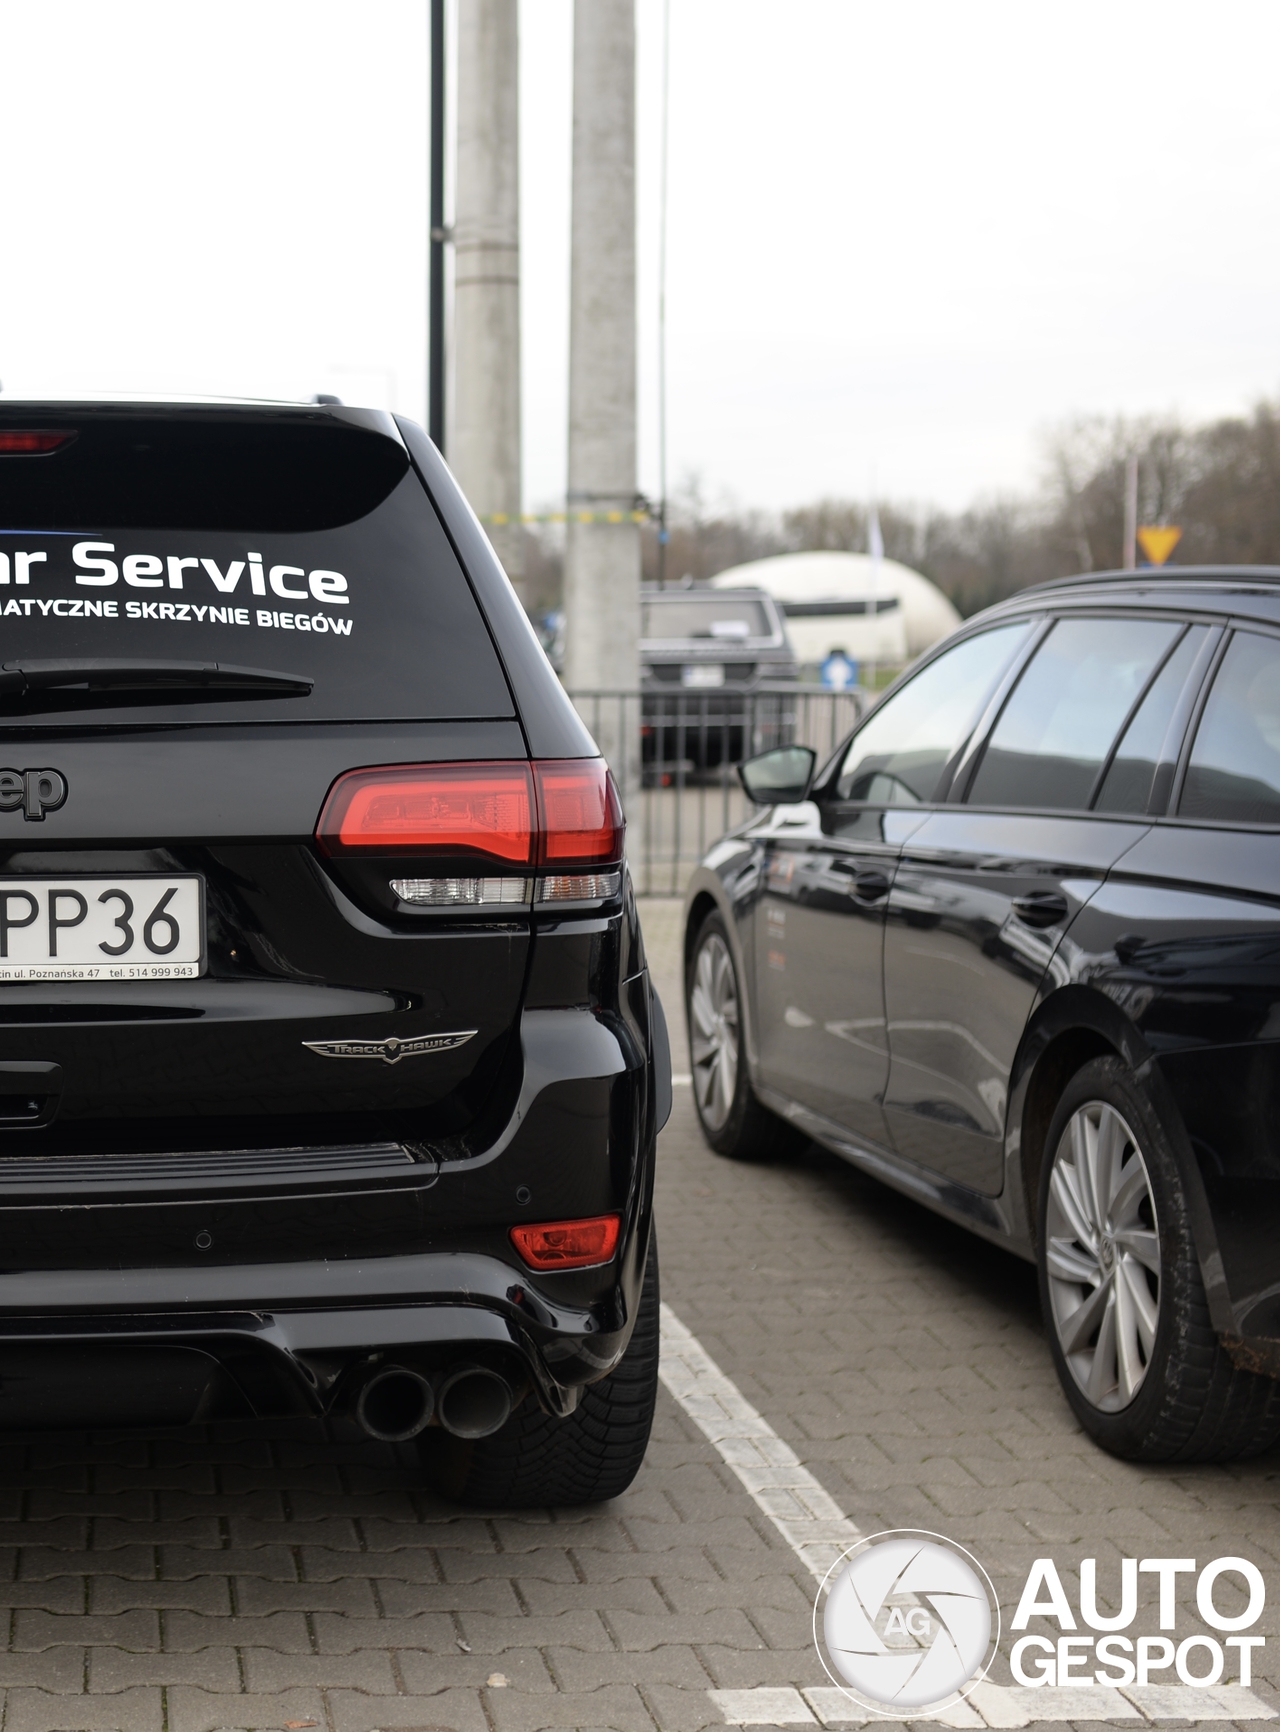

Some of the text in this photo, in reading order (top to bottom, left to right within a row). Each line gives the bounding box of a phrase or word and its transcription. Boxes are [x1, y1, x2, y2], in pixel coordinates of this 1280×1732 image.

[71, 541, 350, 605] Service
[125, 601, 251, 626] SKRZYNIE
[256, 608, 354, 636] BIEGÓW
[14, 969, 26, 979] ul.
[29, 968, 84, 978] Poznańska
[87, 969, 100, 978] 47
[109, 968, 126, 978] tel.
[129, 968, 148, 977] 514
[151, 967, 171, 977] 999
[173, 967, 193, 976] 943
[400, 1038, 452, 1052] HAWK
